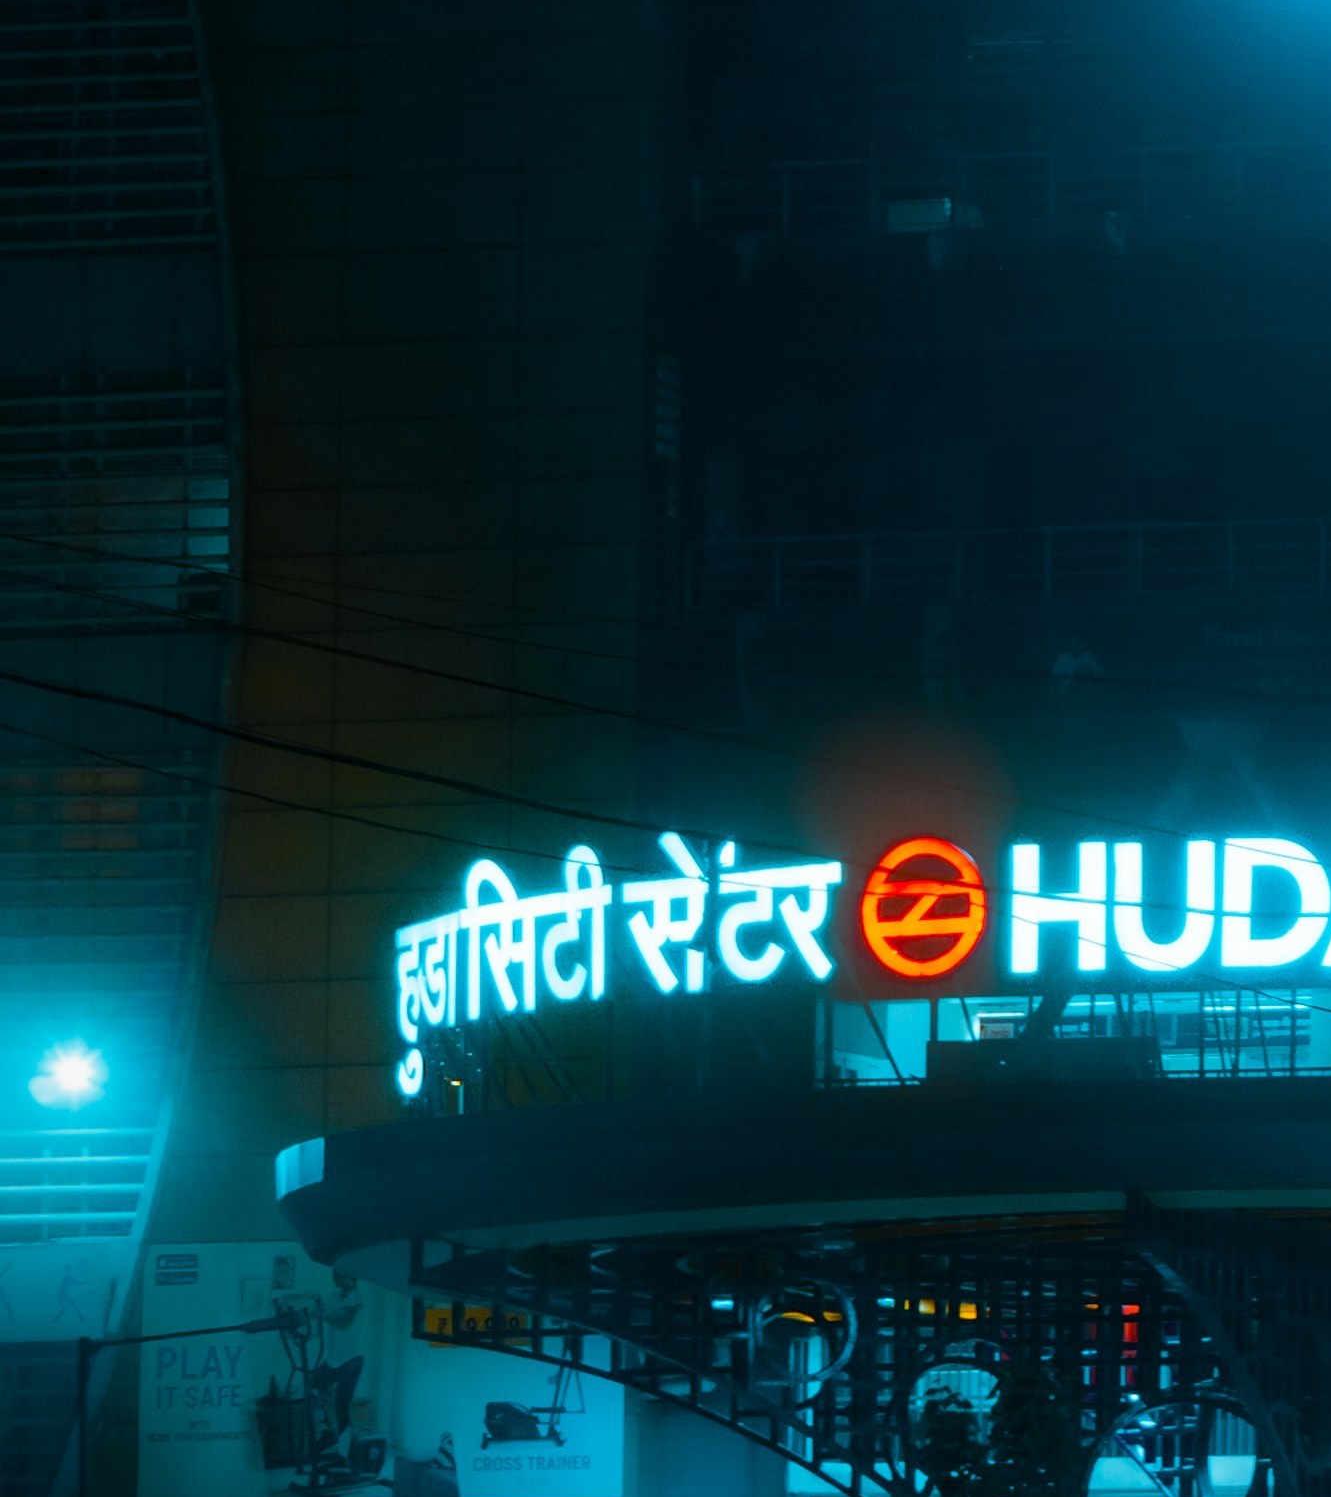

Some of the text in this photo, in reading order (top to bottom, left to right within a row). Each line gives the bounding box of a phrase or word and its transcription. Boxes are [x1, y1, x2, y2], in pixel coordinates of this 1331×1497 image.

[458, 844, 613, 1020] सिटी
[156, 1344, 244, 1380] PLAY
[156, 1384, 244, 1409] IT SAFE
[472, 1454, 591, 1472] CROSS TRAINER
